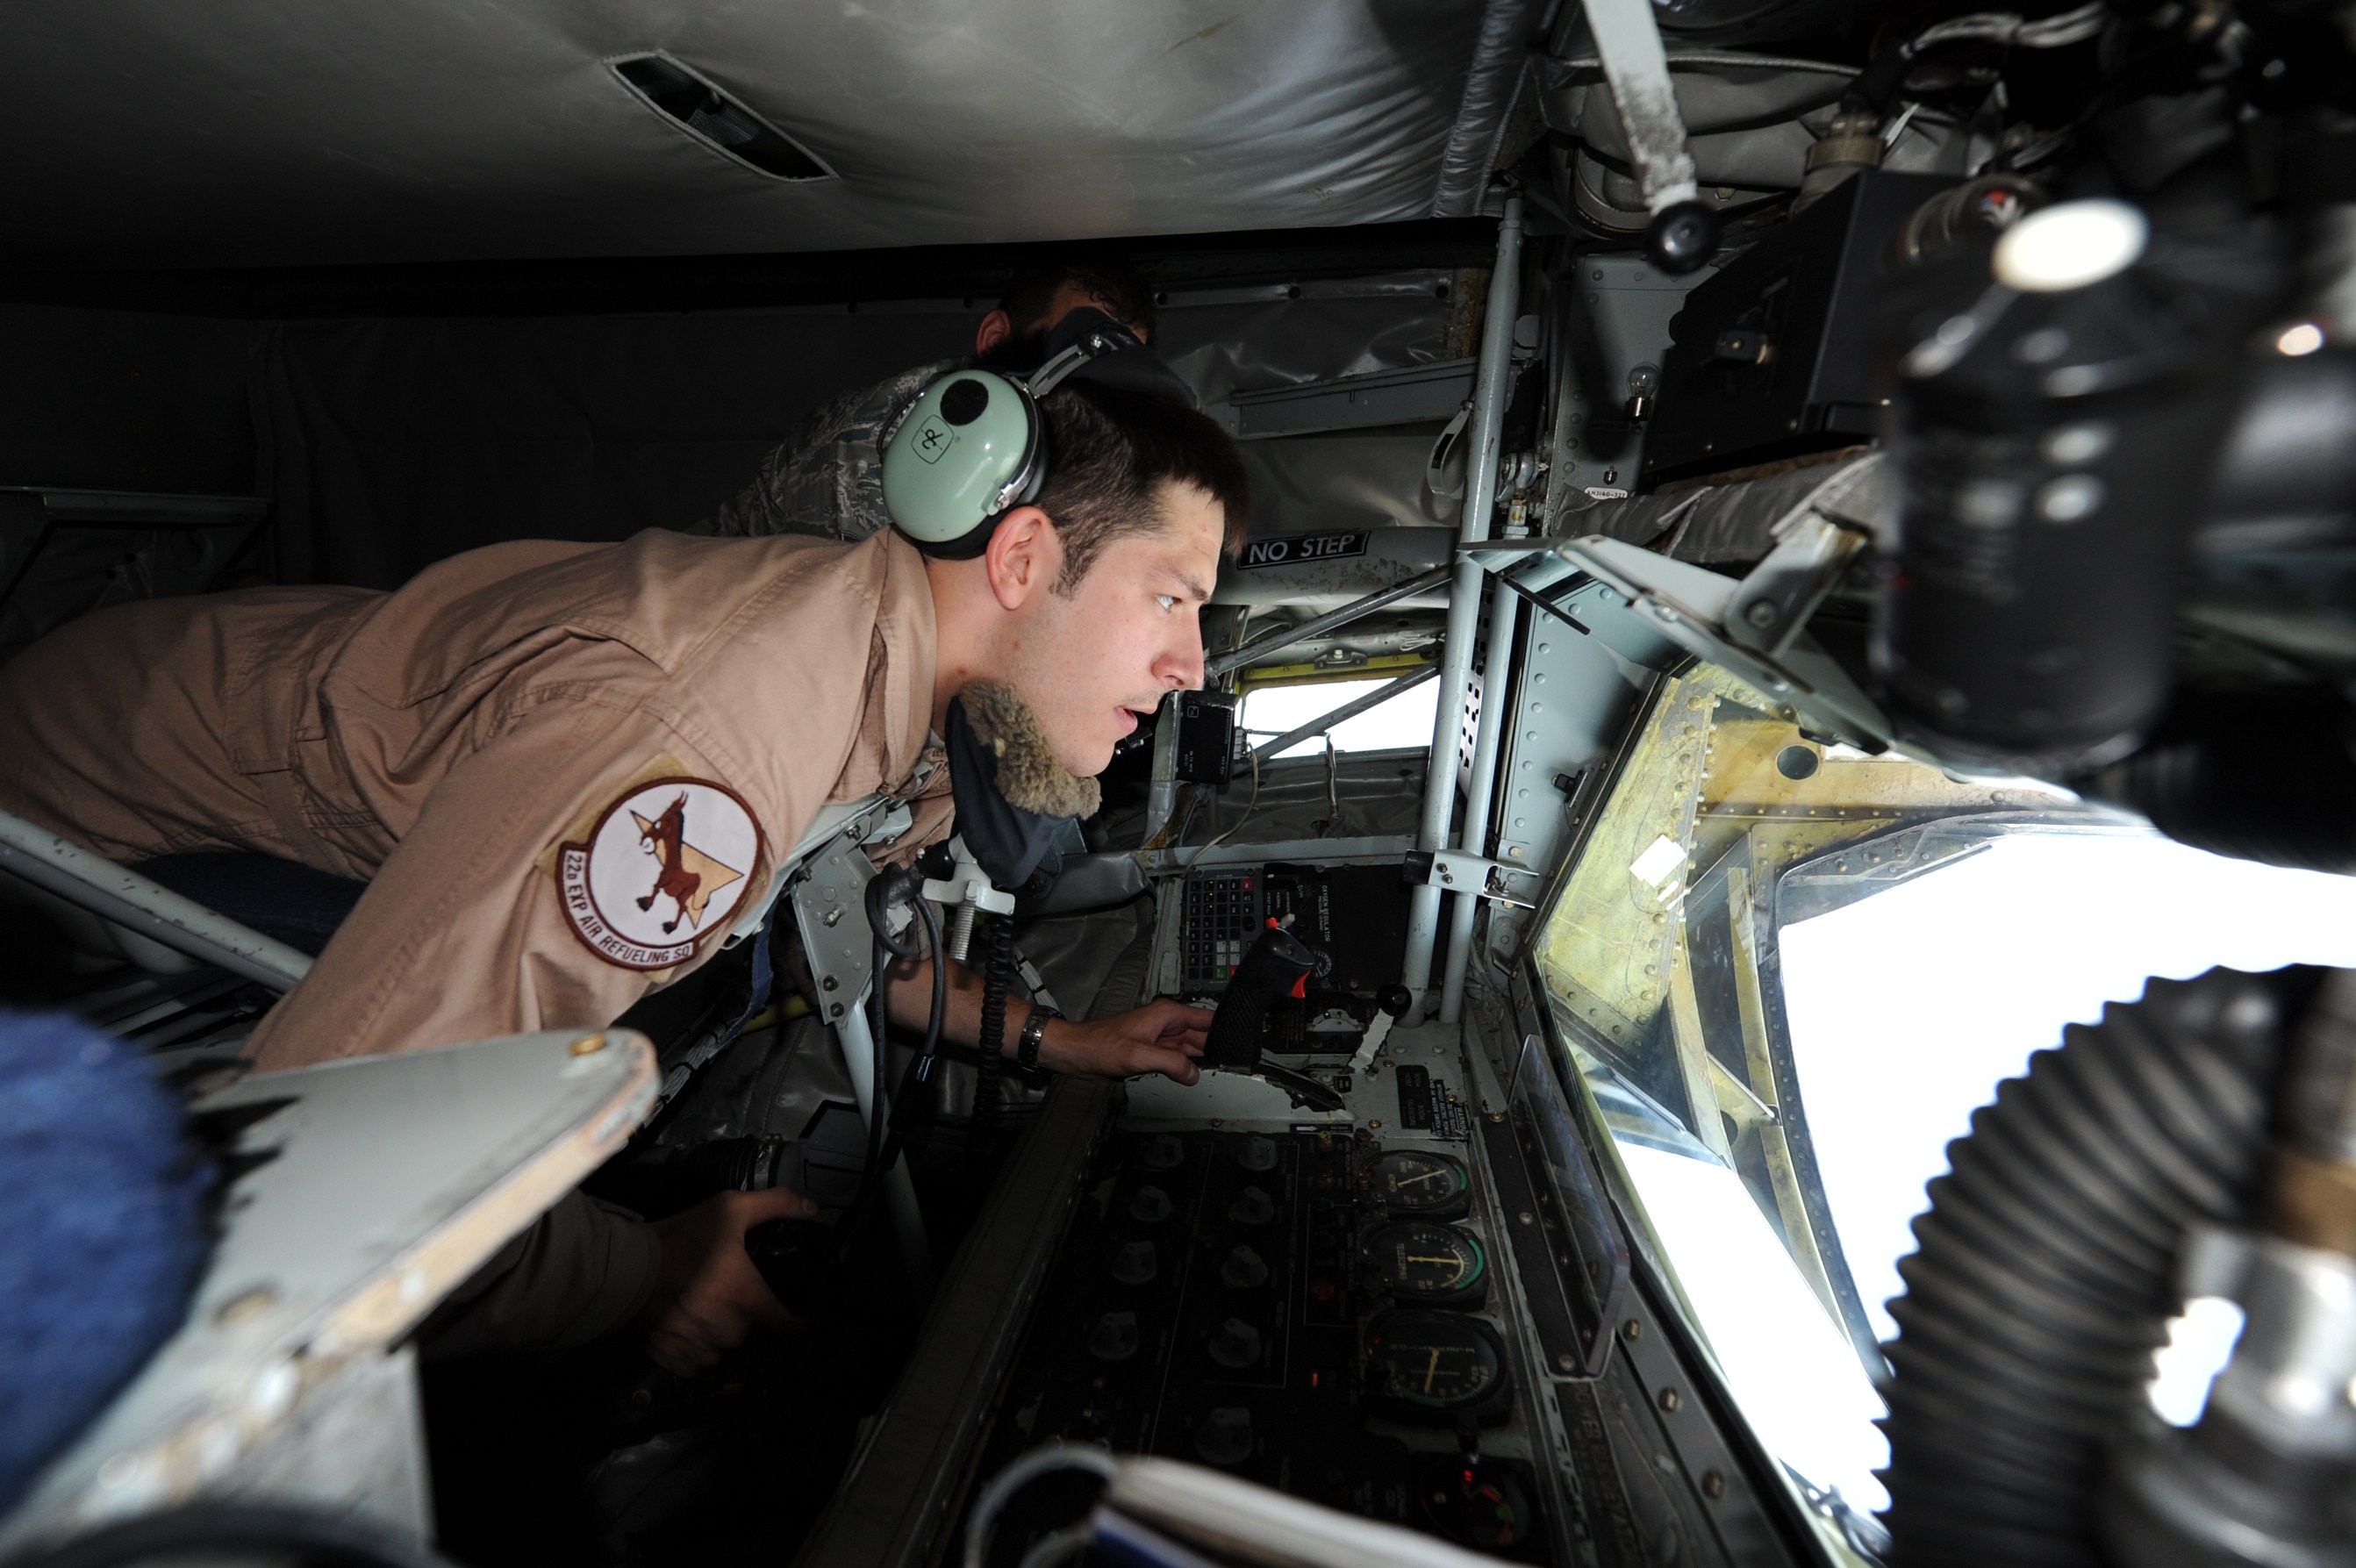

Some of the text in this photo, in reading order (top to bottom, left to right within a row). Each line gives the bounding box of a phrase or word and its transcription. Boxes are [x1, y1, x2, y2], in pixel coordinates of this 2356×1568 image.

[1249, 534, 1356, 563] NO STEP
[567, 884, 588, 911] EXP
[578, 914, 603, 938] AIR
[598, 935, 670, 963] REFUELING
[673, 946, 690, 959] SQ
[1396, 1242, 1407, 1280] TELESCOPING
